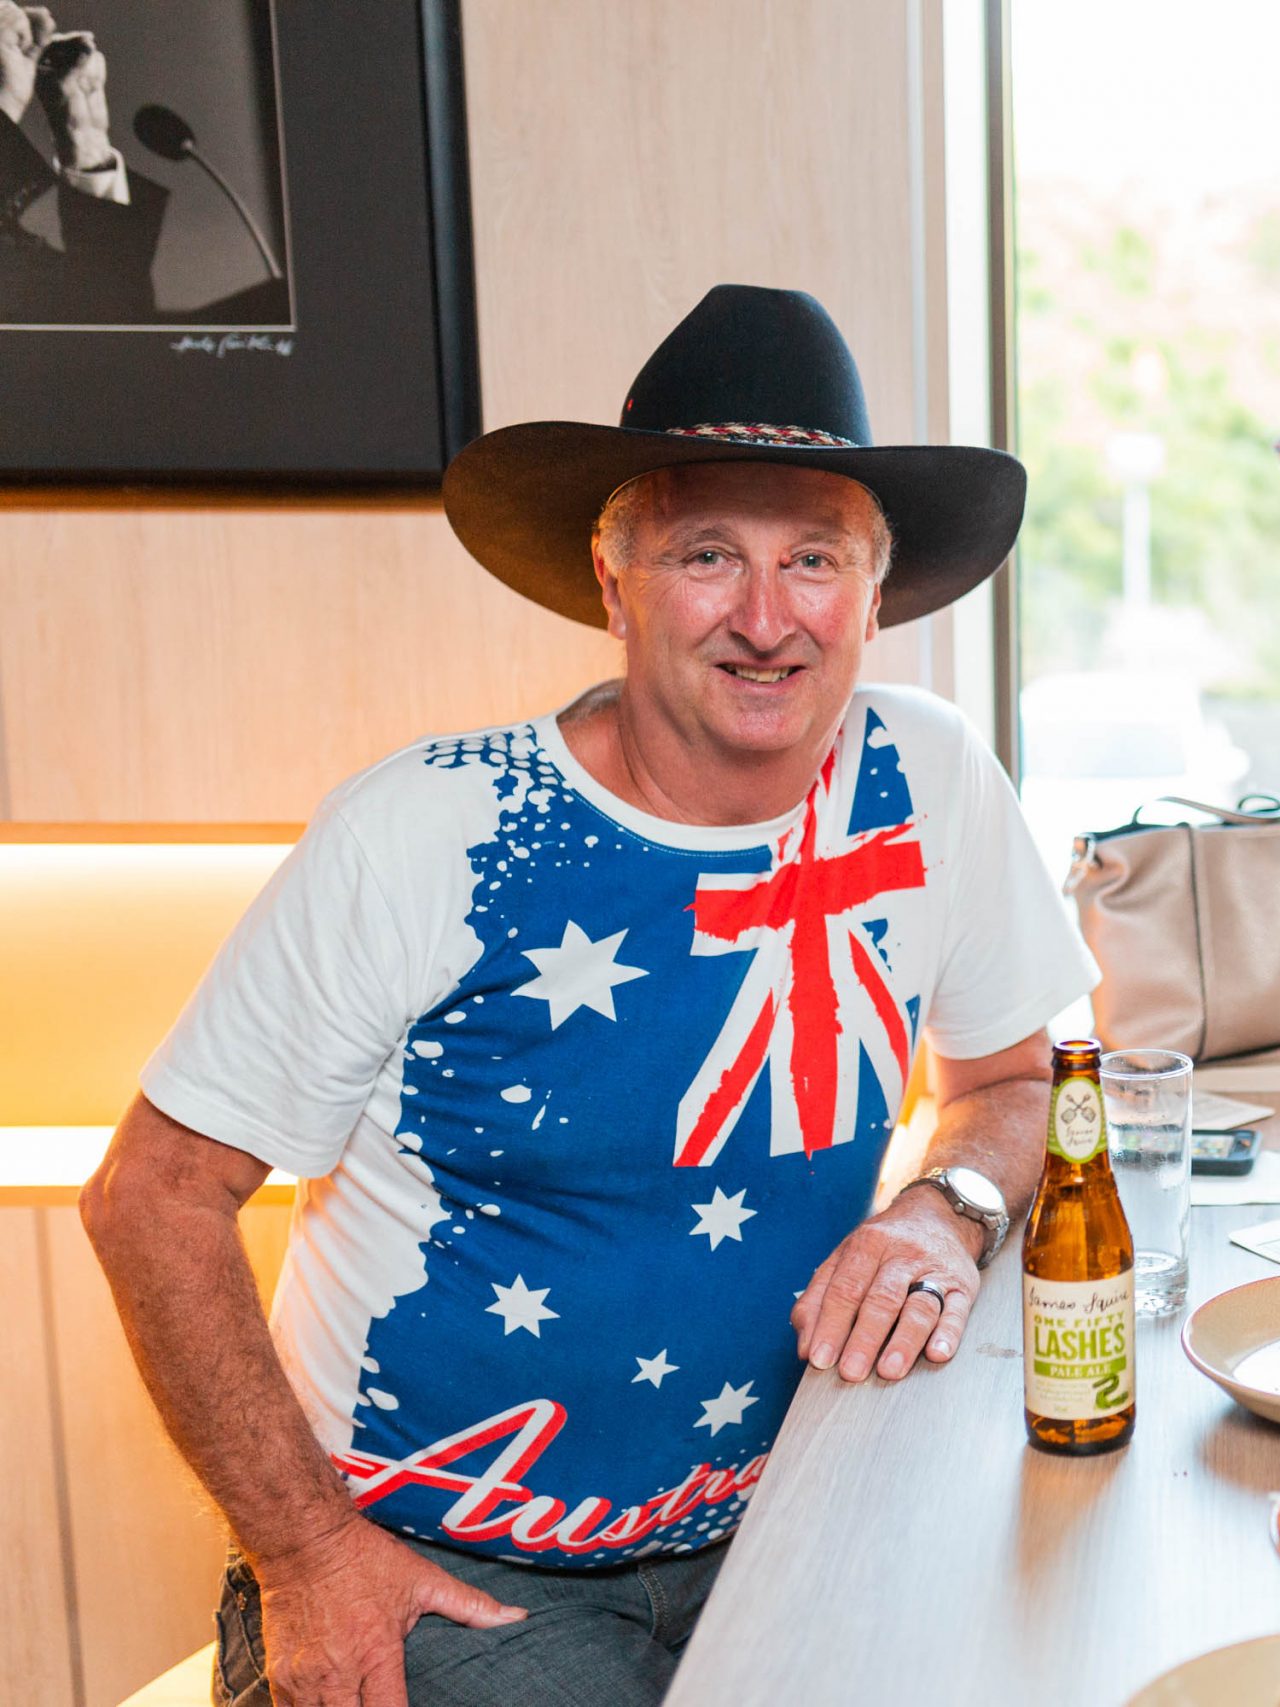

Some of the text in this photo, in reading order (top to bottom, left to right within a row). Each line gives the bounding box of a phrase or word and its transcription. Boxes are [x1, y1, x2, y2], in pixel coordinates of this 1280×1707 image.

[1034, 1314, 1066, 1328] ONE
[1034, 1322, 1126, 1360] LASHES
[1050, 1363, 1111, 1378] PALE ALE
